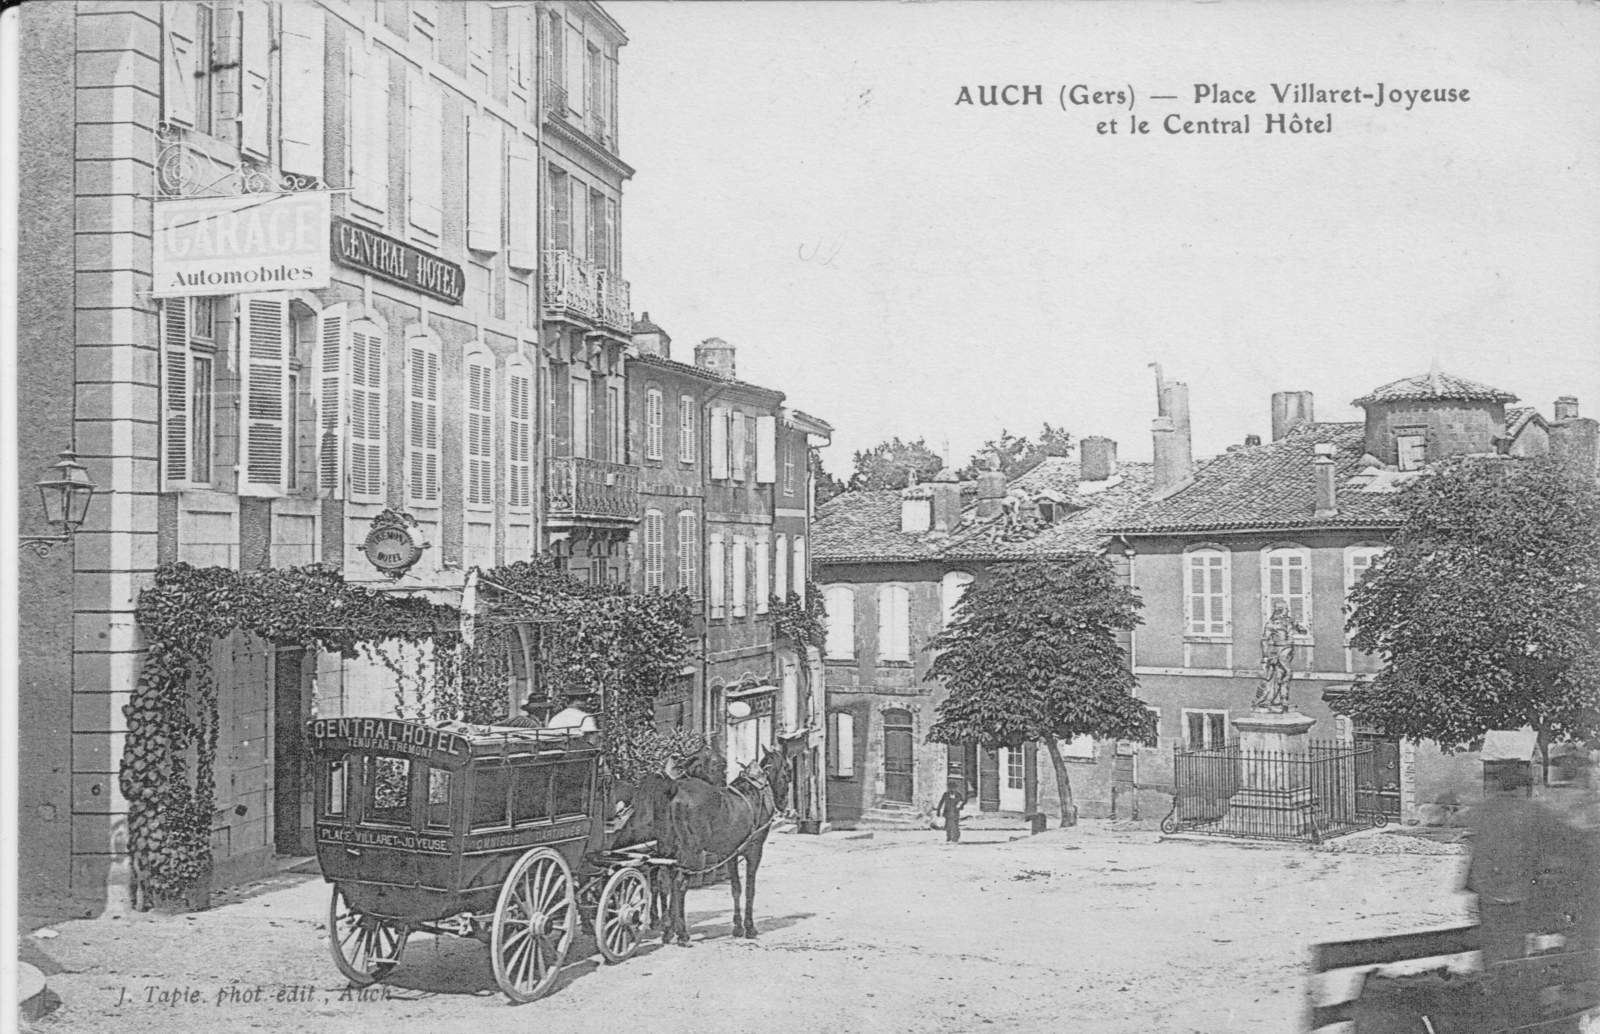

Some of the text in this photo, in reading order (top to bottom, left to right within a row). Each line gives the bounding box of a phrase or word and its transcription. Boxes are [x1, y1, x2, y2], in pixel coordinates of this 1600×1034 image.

[167, 205, 317, 258] GARAGE
[171, 265, 313, 287] Automobiles
[340, 223, 460, 296] CENTRAL HOTEL
[314, 718, 460, 755] CENTRAL HOTEL
